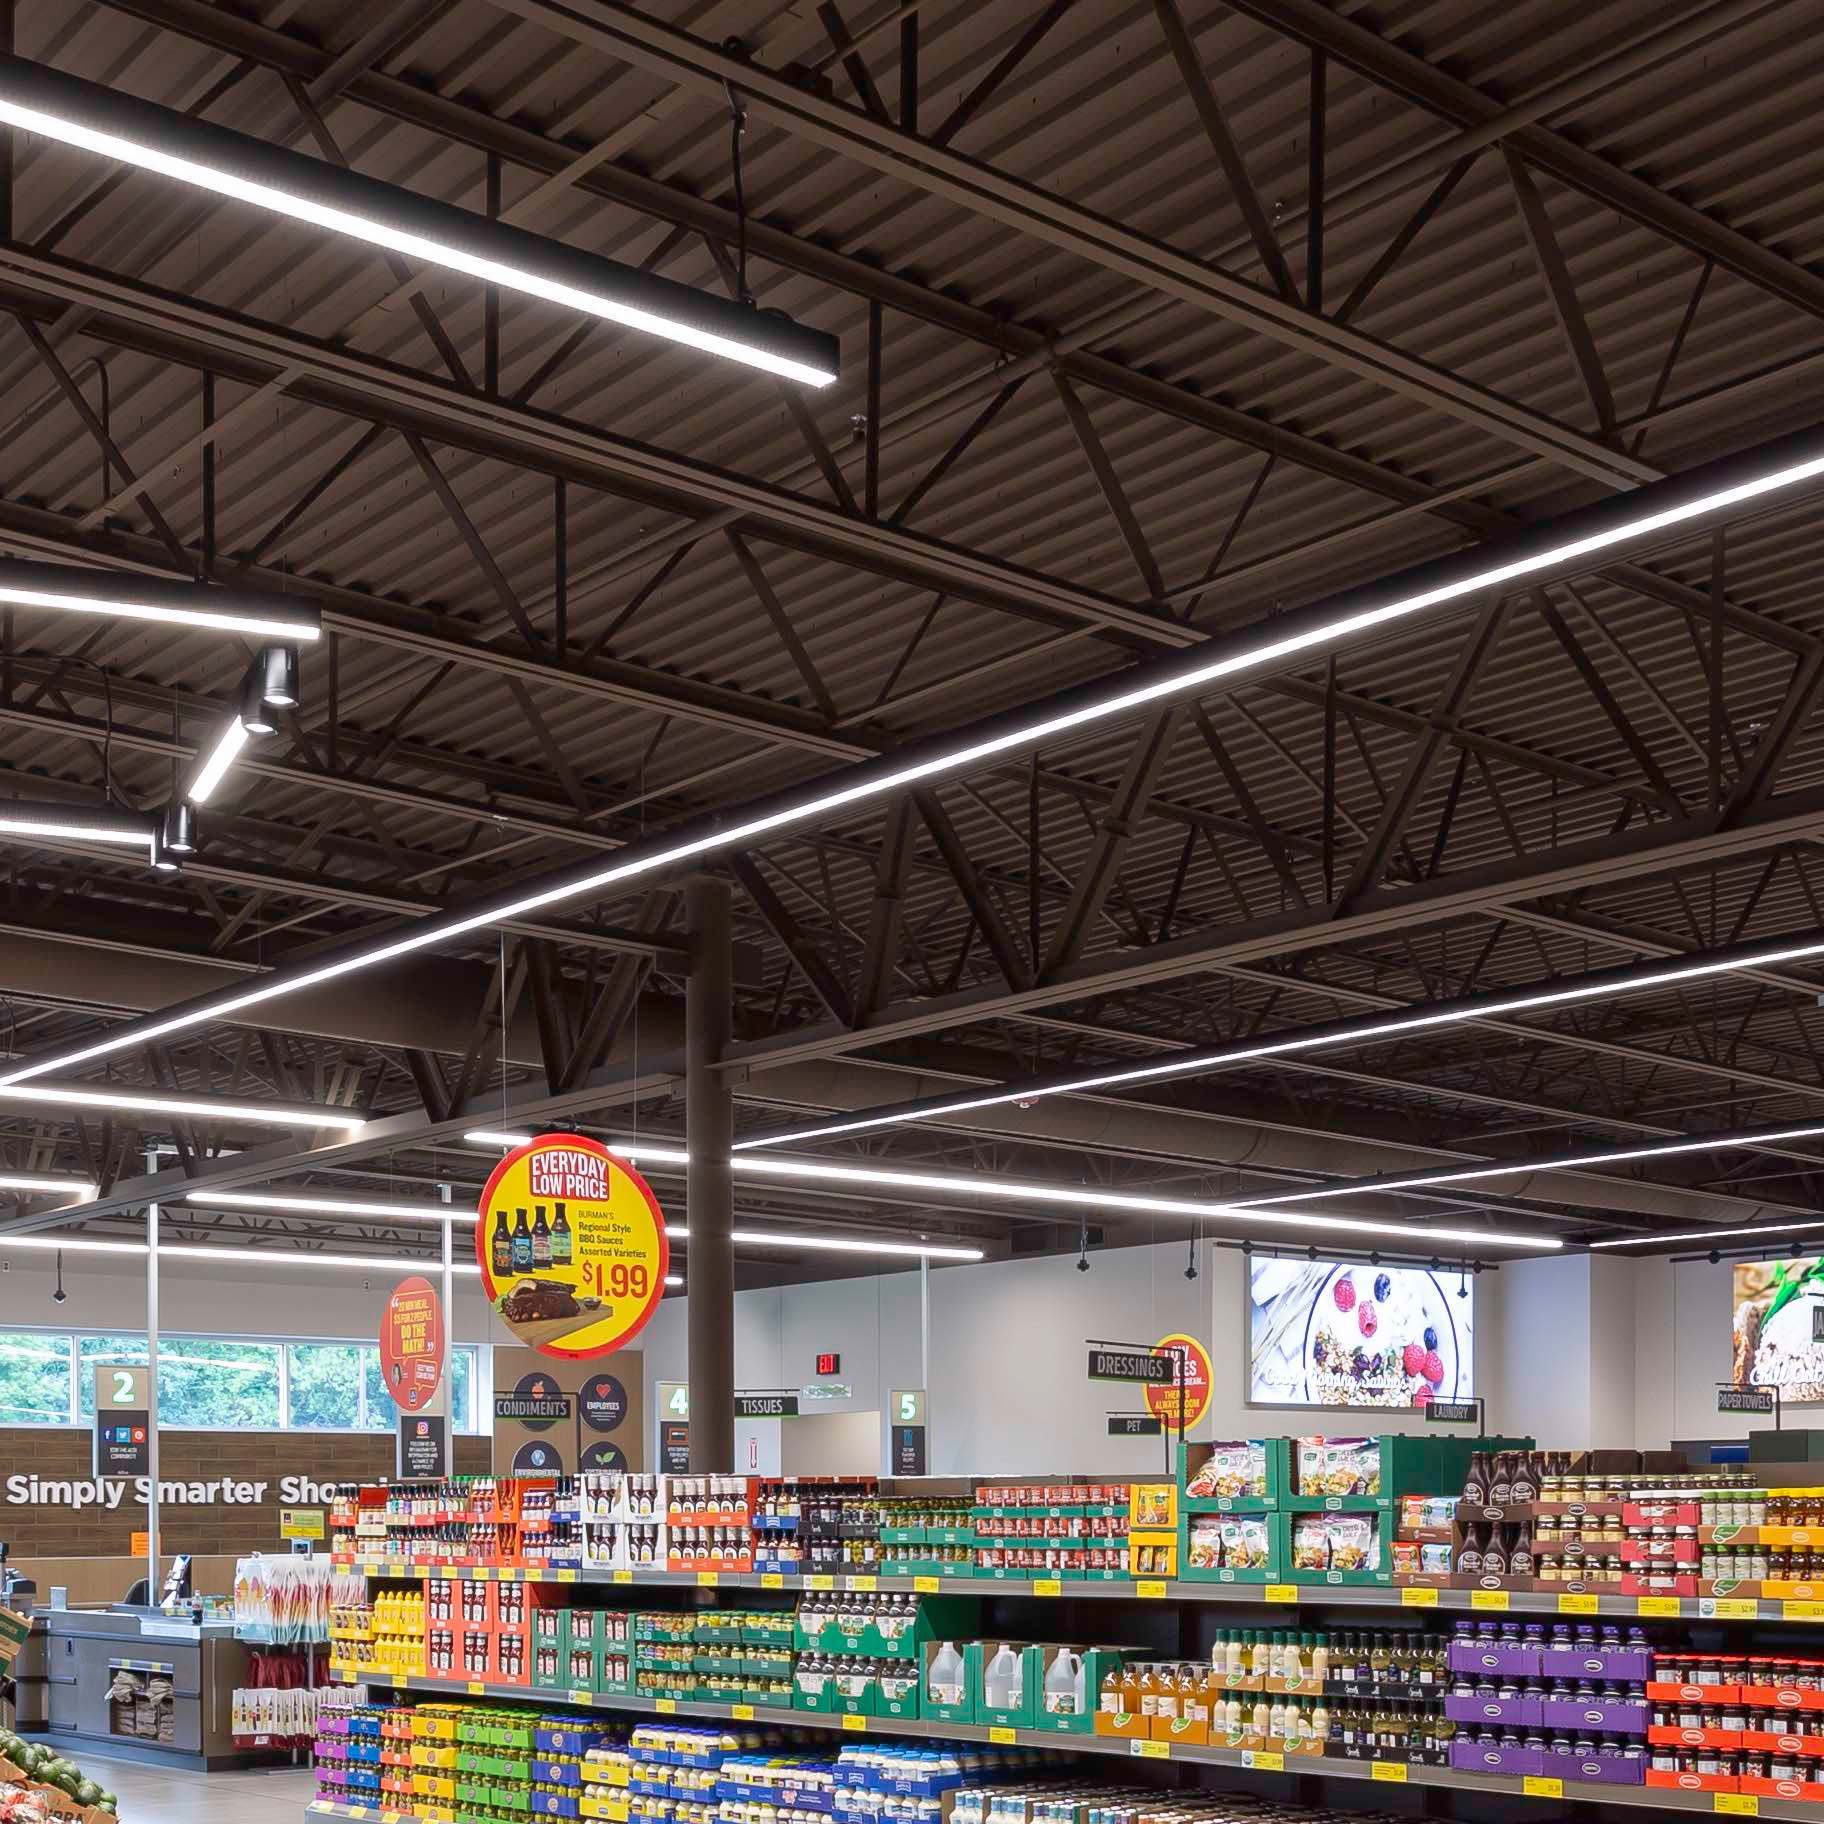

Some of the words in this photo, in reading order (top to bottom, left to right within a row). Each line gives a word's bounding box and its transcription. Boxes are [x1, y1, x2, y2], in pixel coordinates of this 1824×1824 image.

[532, 1151, 606, 1181] EVERYDAY
[533, 1175, 562, 1196] LOW
[566, 1176, 608, 1199] PRICE
[579, 1222, 610, 1233] Regional
[613, 1224, 631, 1234] Style
[579, 1235, 594, 1245] BBQ
[597, 1235, 623, 1245] Sauces
[579, 1247, 612, 1257] Assorted
[614, 1249, 647, 1259] Varieties
[582, 1260, 648, 1298] $1.99
[1097, 1355, 1163, 1377] DRESSINGS
[112, 1371, 135, 1403] 2
[496, 1401, 567, 1416] CONDIMENTS
[669, 1388, 688, 1415] 4
[742, 1399, 783, 1414] TISSUES
[900, 1394, 916, 1420] 5
[1433, 1404, 1469, 1419] LAUNDRY
[1718, 1391, 1741, 1409] PAPER
[1742, 1394, 1772, 1411] TOWELS
[1127, 1421, 1141, 1432] PET
[6, 1476, 126, 1509] Simply
